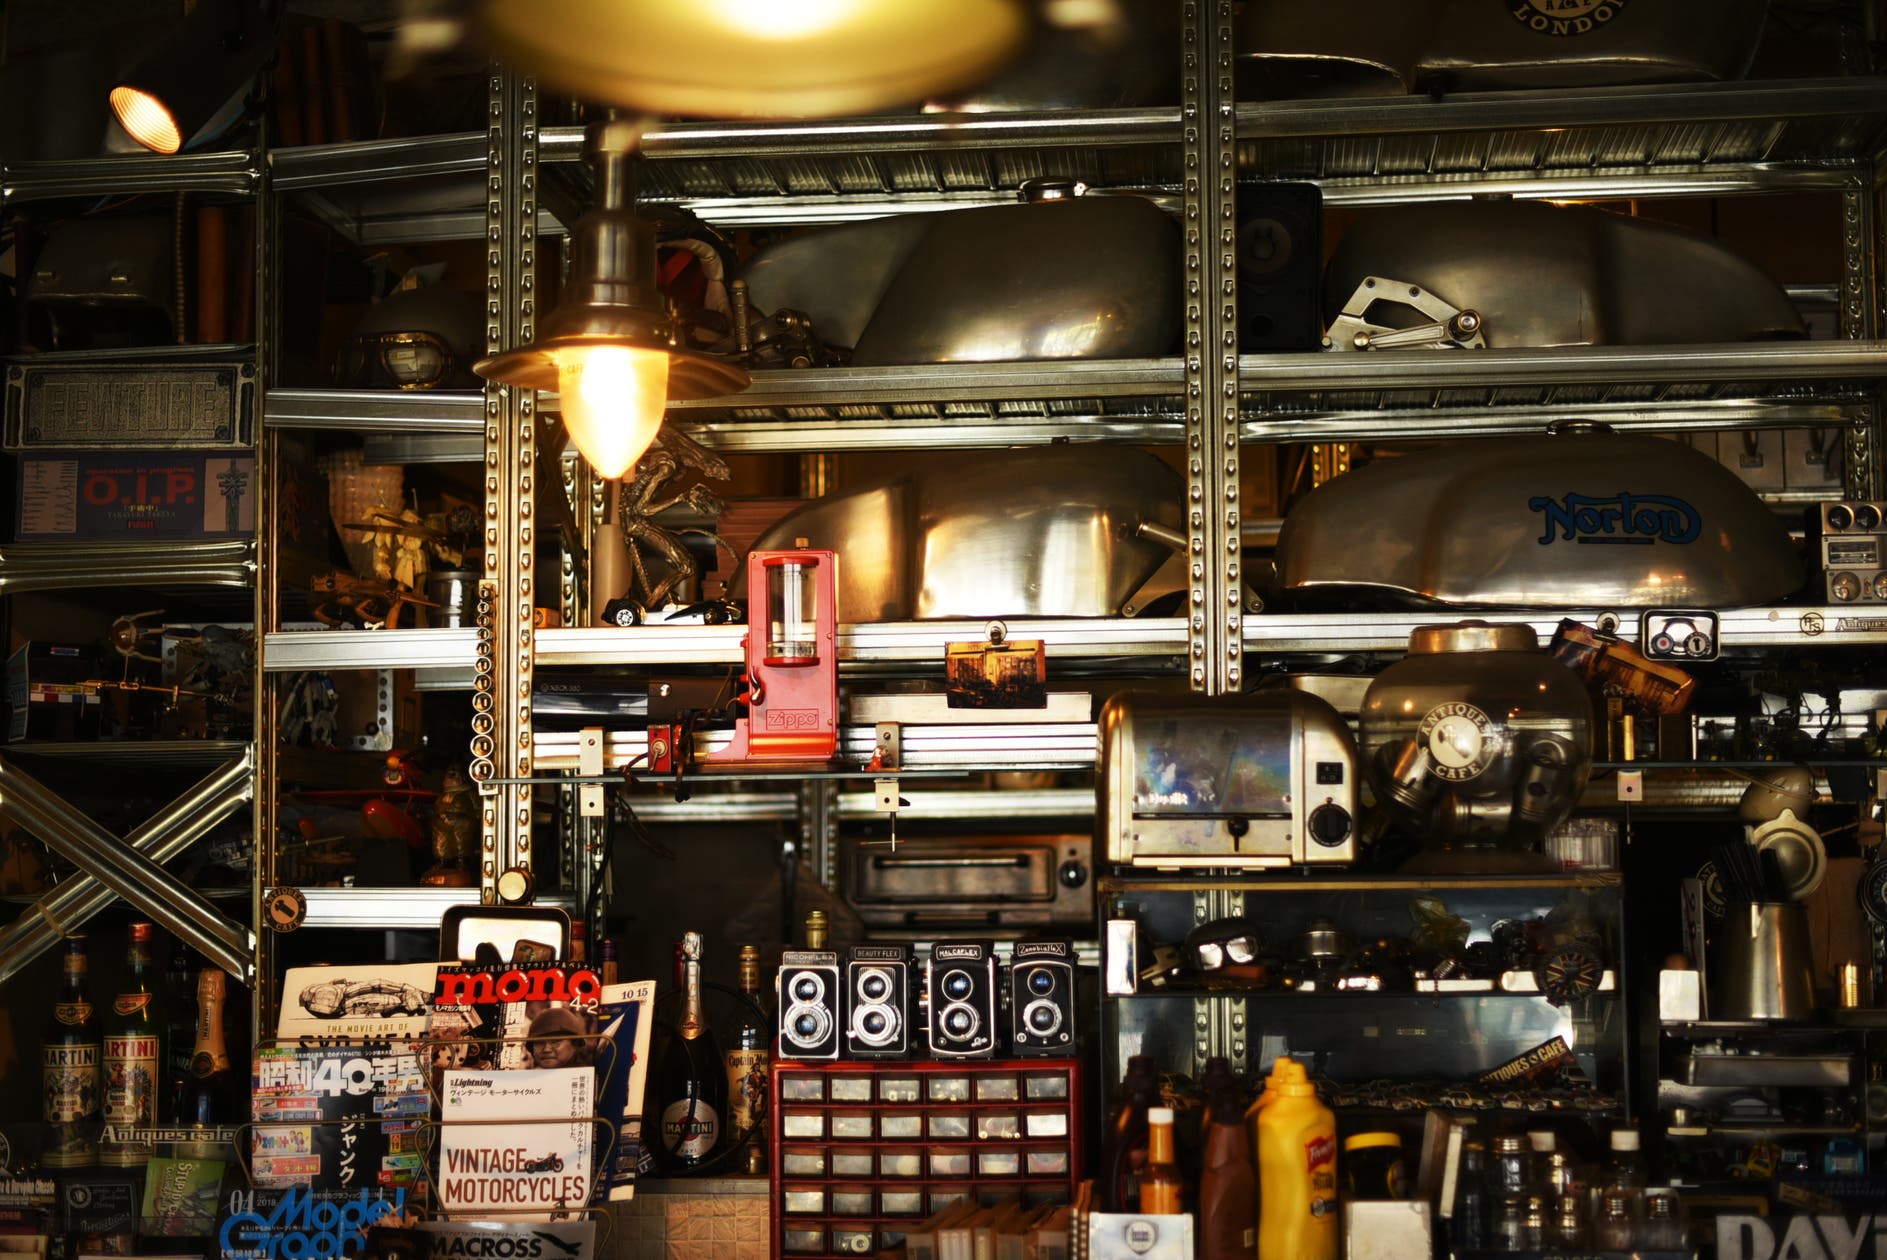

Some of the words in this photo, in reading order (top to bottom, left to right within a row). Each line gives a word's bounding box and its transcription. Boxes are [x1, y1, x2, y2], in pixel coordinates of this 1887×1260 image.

[42, 380, 216, 432] FEWTURE
[1528, 491, 1702, 545] Norton
[1435, 762, 1480, 779] CAFE
[434, 970, 601, 1005] mono
[327, 1025, 342, 1033] THE
[347, 1025, 374, 1033] MOVIE
[378, 1024, 394, 1032] ART
[398, 1023, 409, 1031] OF
[103, 1040, 156, 1058] ARTINI
[1537, 1039, 1567, 1062] CAFE
[455, 1078, 494, 1089] Lightning
[97, 1124, 187, 1147] Antiques
[666, 1122, 714, 1135] MATINI
[446, 1148, 527, 1174] VINTAGE
[445, 1175, 585, 1204] MOTORCYCLES
[266, 1186, 407, 1233] Model
[219, 1210, 367, 1260] Graph
[431, 1236, 542, 1258] MACROSS
